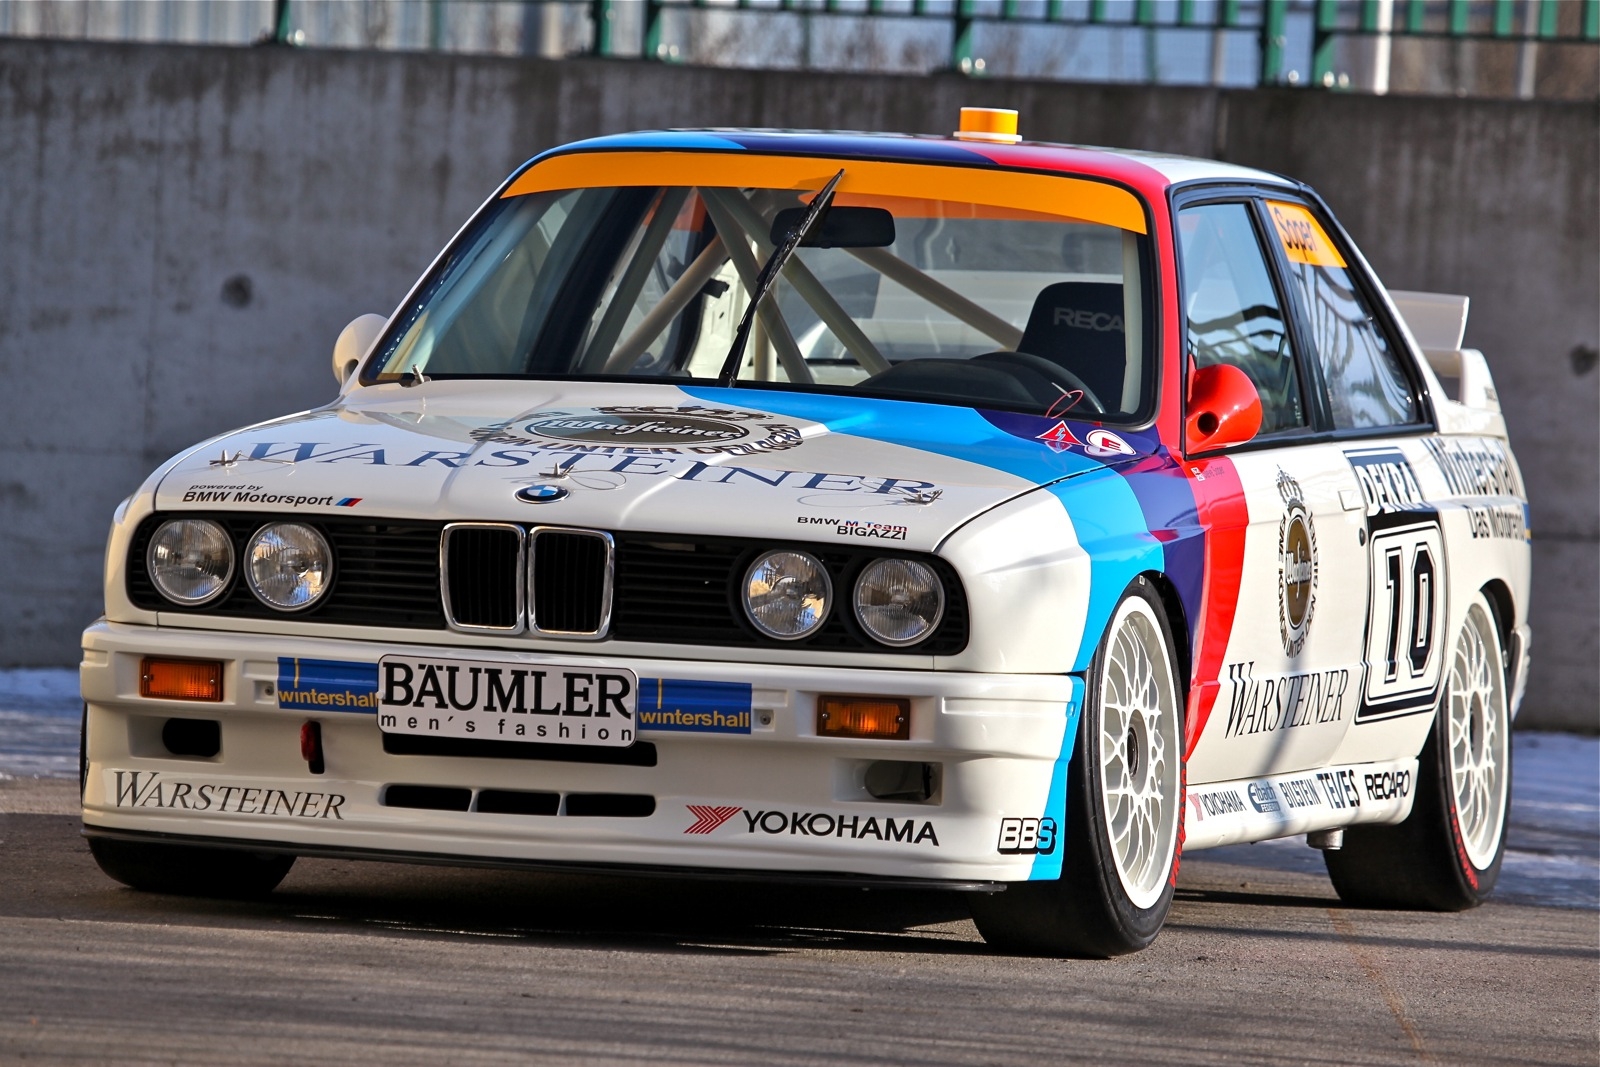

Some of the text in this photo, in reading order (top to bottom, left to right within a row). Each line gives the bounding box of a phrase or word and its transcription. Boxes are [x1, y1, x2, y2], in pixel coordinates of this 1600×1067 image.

[189, 483, 246, 492] powered
[247, 442, 937, 502] WARSTEINER
[1354, 461, 1423, 516] DEKRA
[182, 491, 336, 508] BMW Motorsport
[797, 517, 841, 526] BMW
[864, 521, 908, 532] Team
[836, 525, 907, 541] BIGAZZI
[1383, 542, 1436, 685] 10
[278, 688, 378, 708] wintershall
[381, 662, 634, 720] BÄUMLER
[1224, 661, 1348, 741] WARSTEINER
[498, 717, 633, 742] fashion
[638, 708, 750, 729] wintershall
[113, 771, 347, 821] WARSTEINER
[1199, 789, 1248, 816] YOKOHAMA
[1316, 769, 1361, 809] TEVES
[1364, 770, 1410, 801] RECARO
[742, 809, 940, 846] YOKOHAMA
[997, 817, 1057, 856] BBS
